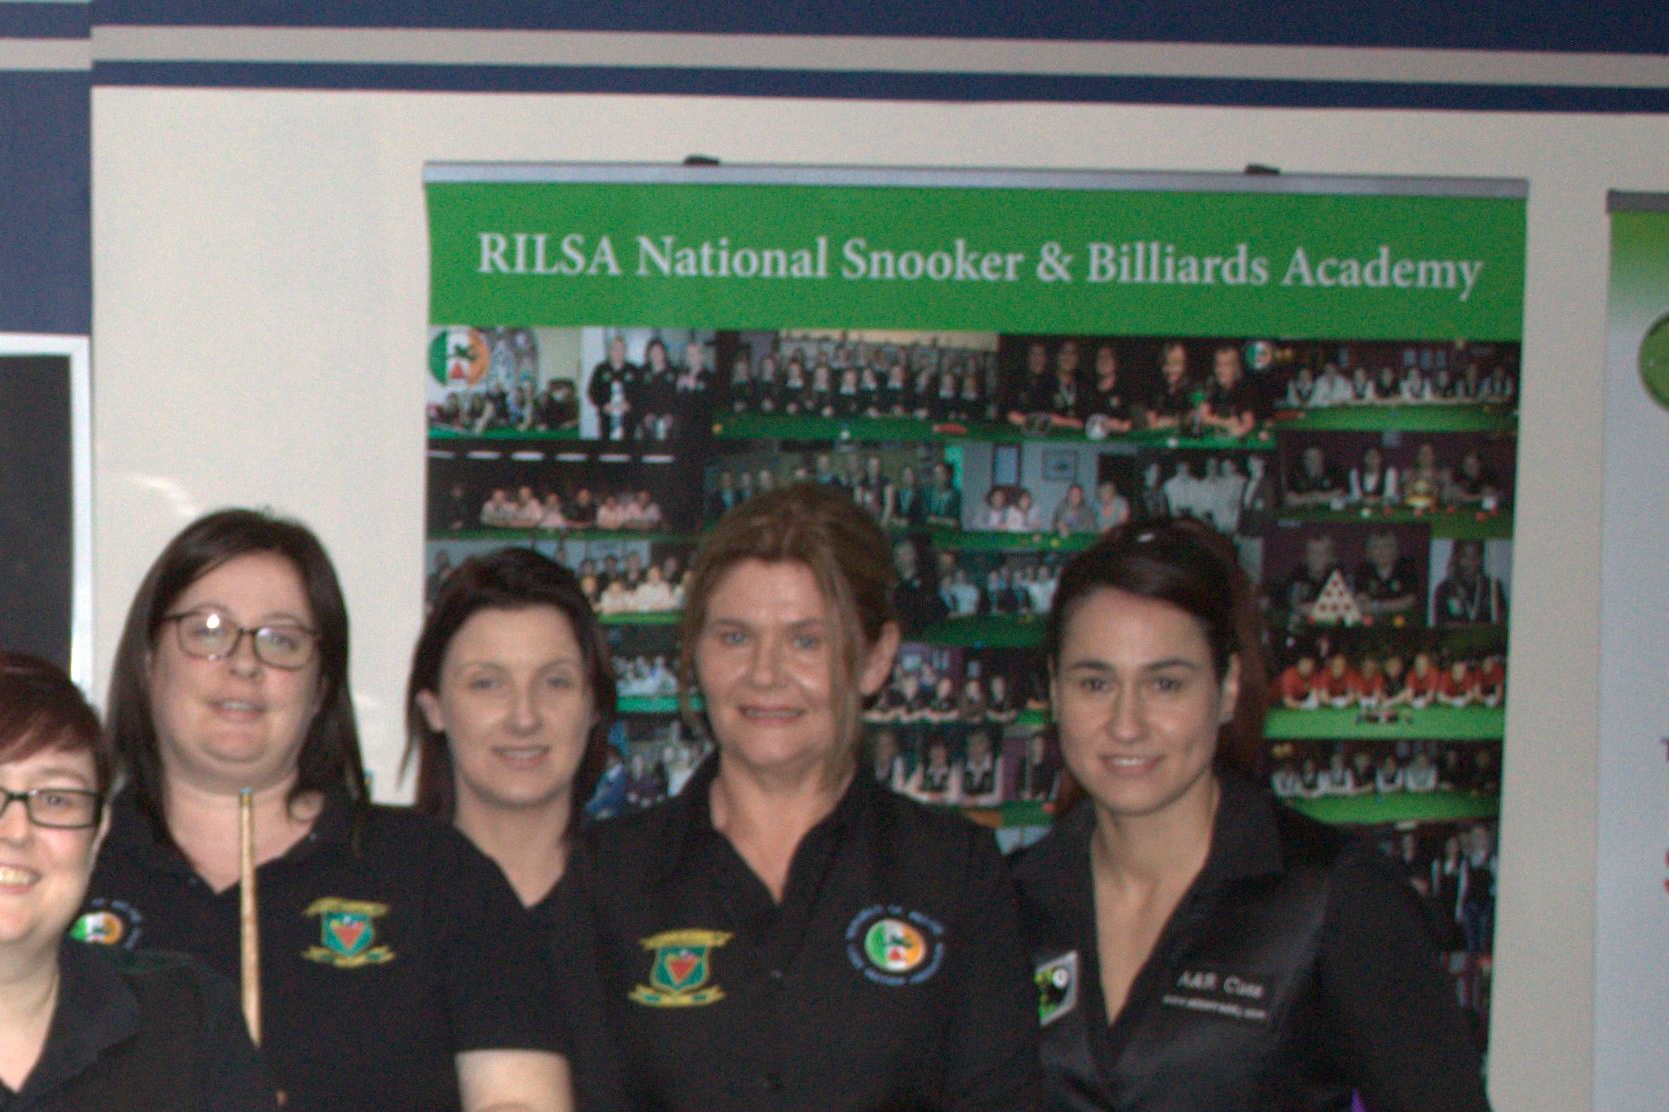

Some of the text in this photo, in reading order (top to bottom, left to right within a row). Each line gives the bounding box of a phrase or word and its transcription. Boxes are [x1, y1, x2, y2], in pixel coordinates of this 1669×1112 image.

[478, 232, 1484, 301] RILSA National Snooker & Billiards Academy
